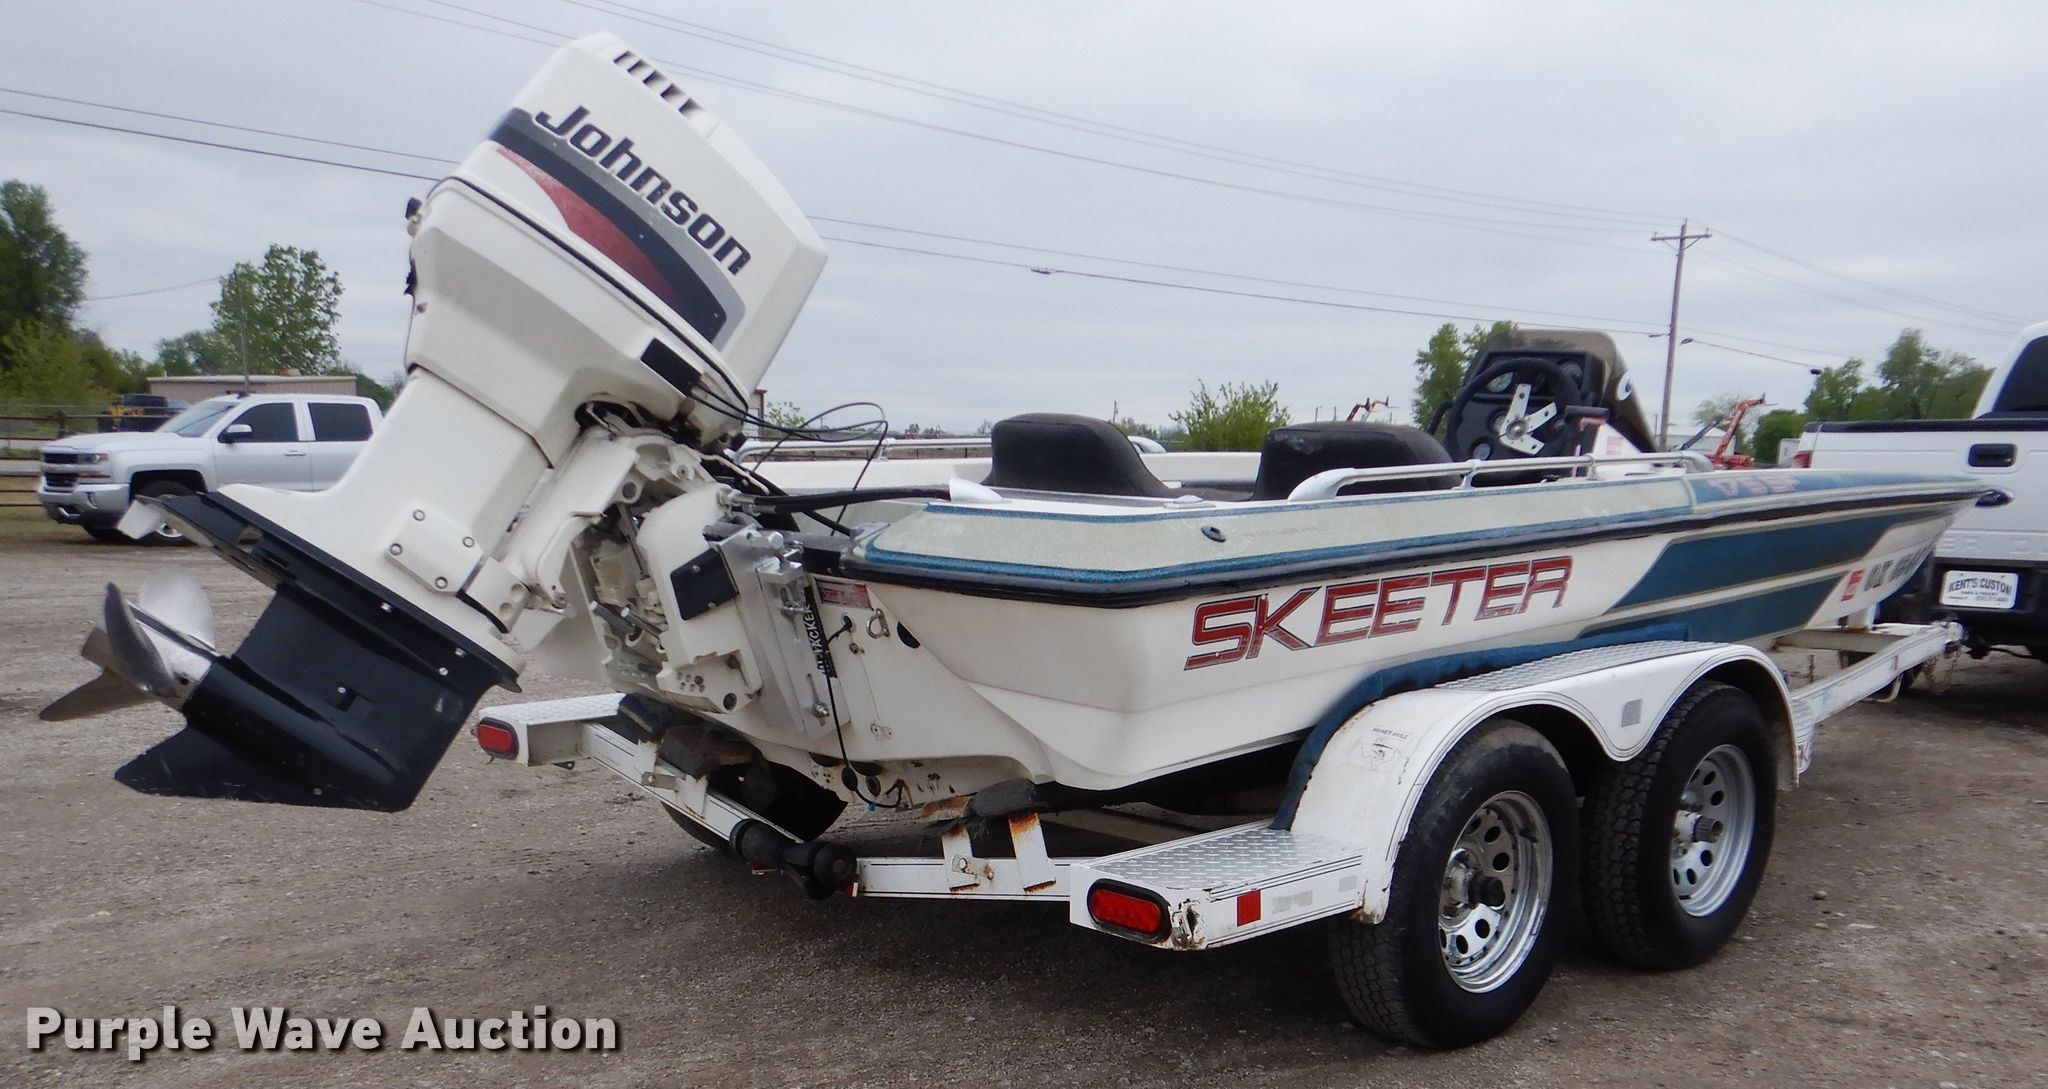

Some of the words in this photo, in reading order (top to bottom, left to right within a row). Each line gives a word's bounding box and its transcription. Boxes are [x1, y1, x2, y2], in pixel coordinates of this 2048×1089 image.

[534, 105, 752, 277] Johnson
[1184, 555, 1574, 671] SKEETER
[1948, 577, 1978, 592] KENT'S
[1979, 577, 2013, 595] CUSTOM
